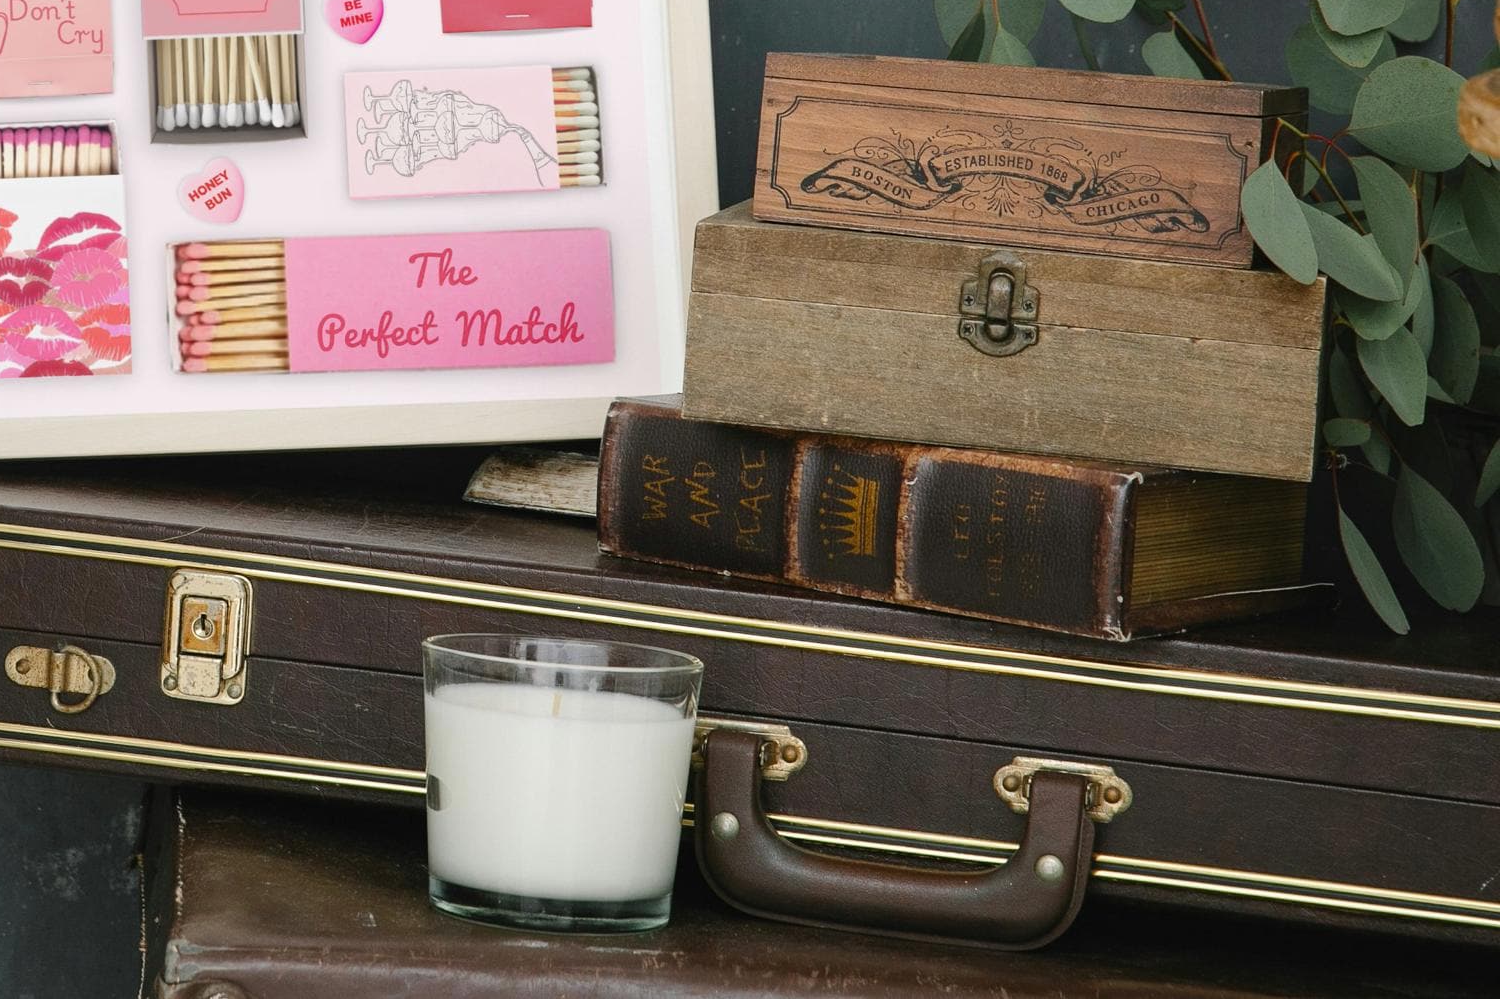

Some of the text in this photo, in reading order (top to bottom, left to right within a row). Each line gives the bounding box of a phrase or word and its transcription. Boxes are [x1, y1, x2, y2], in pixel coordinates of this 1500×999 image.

[57, 20, 104, 54] Cry
[340, 12, 373, 28] MINE
[188, 169, 229, 202] HONEY
[851, 166, 913, 200] BOSTON
[944, 154, 1068, 183] ESTABLISHED 1868
[204, 187, 233, 210] BUN
[1085, 193, 1161, 218] CHICAGO
[408, 247, 478, 288] The
[317, 301, 585, 358] Perfect Match
[643, 455, 677, 519] WAR
[684, 461, 721, 528] AND
[734, 445, 773, 552] PEACE
